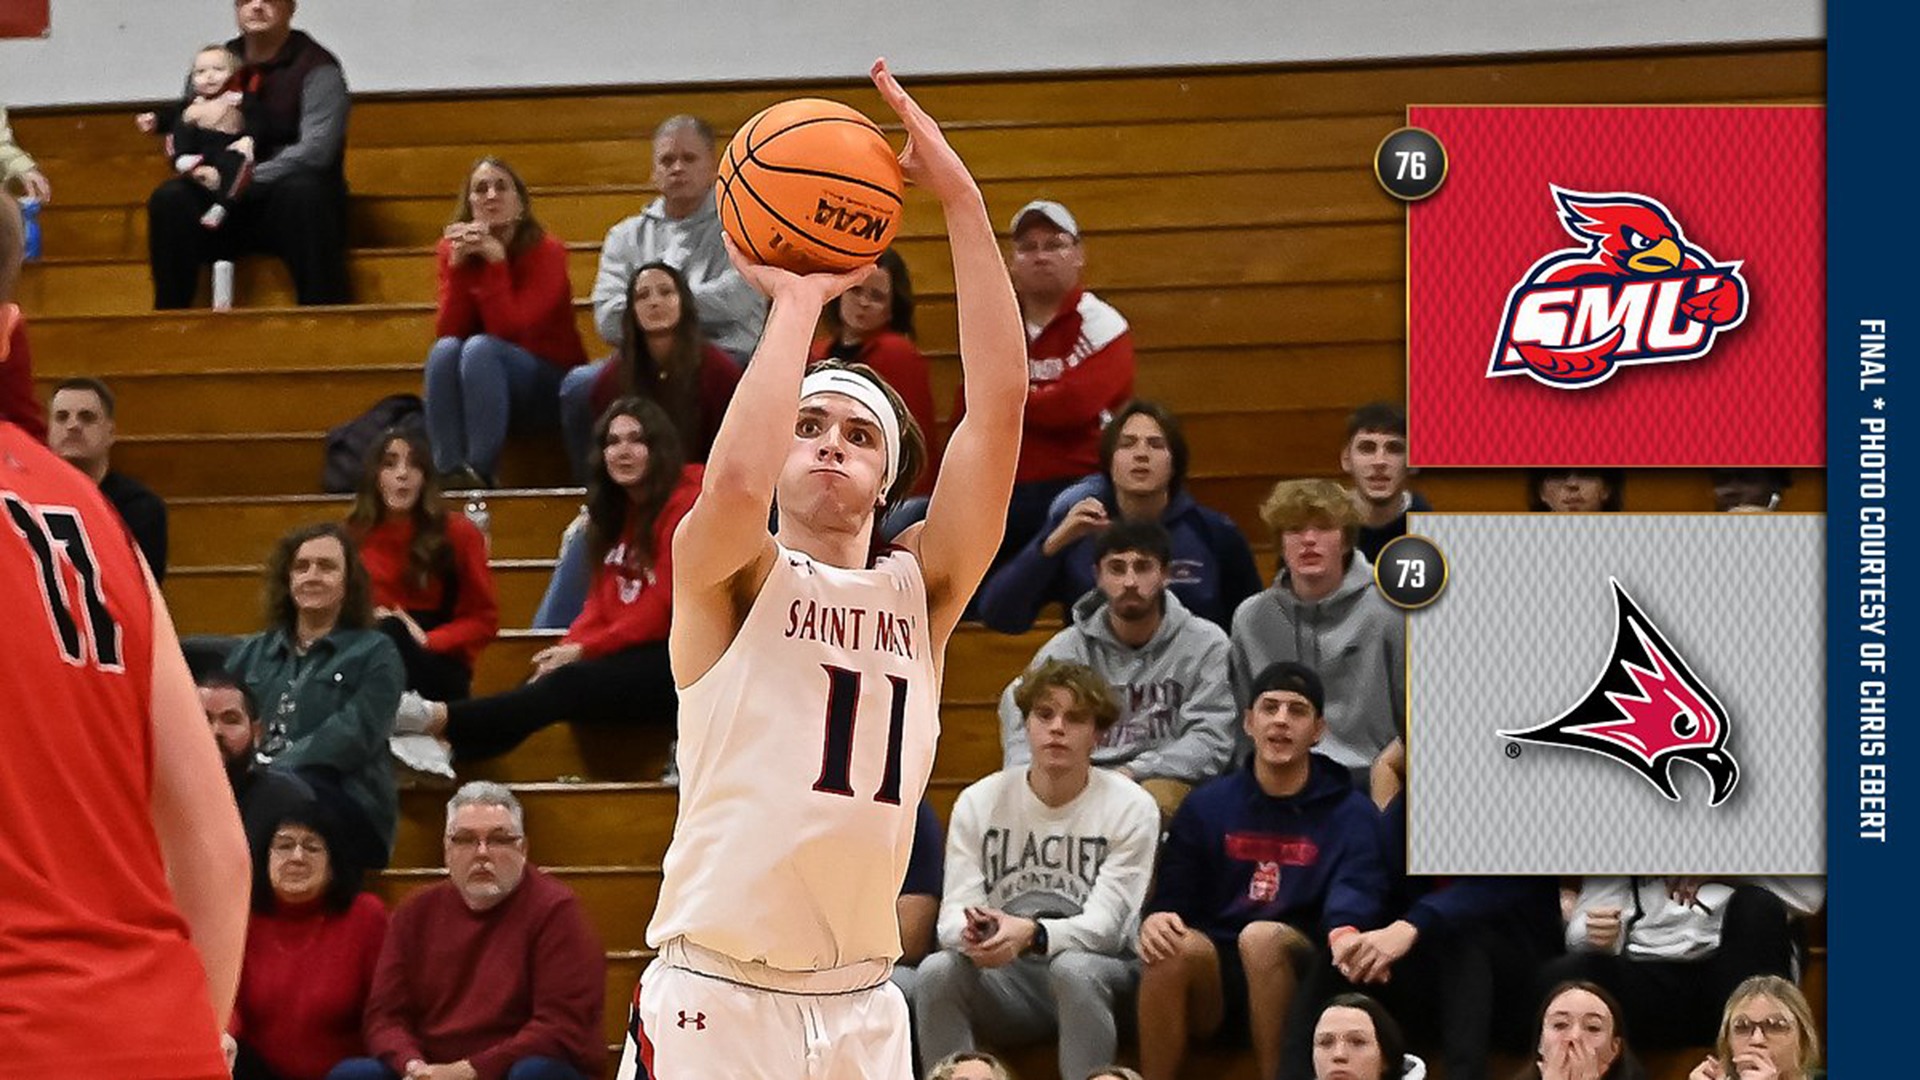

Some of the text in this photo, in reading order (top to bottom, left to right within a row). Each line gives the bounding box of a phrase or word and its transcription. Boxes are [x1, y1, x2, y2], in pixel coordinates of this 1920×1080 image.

[813, 197, 891, 243] NCAA
[784, 599, 867, 650] SAINT
[811, 662, 909, 807] 11
